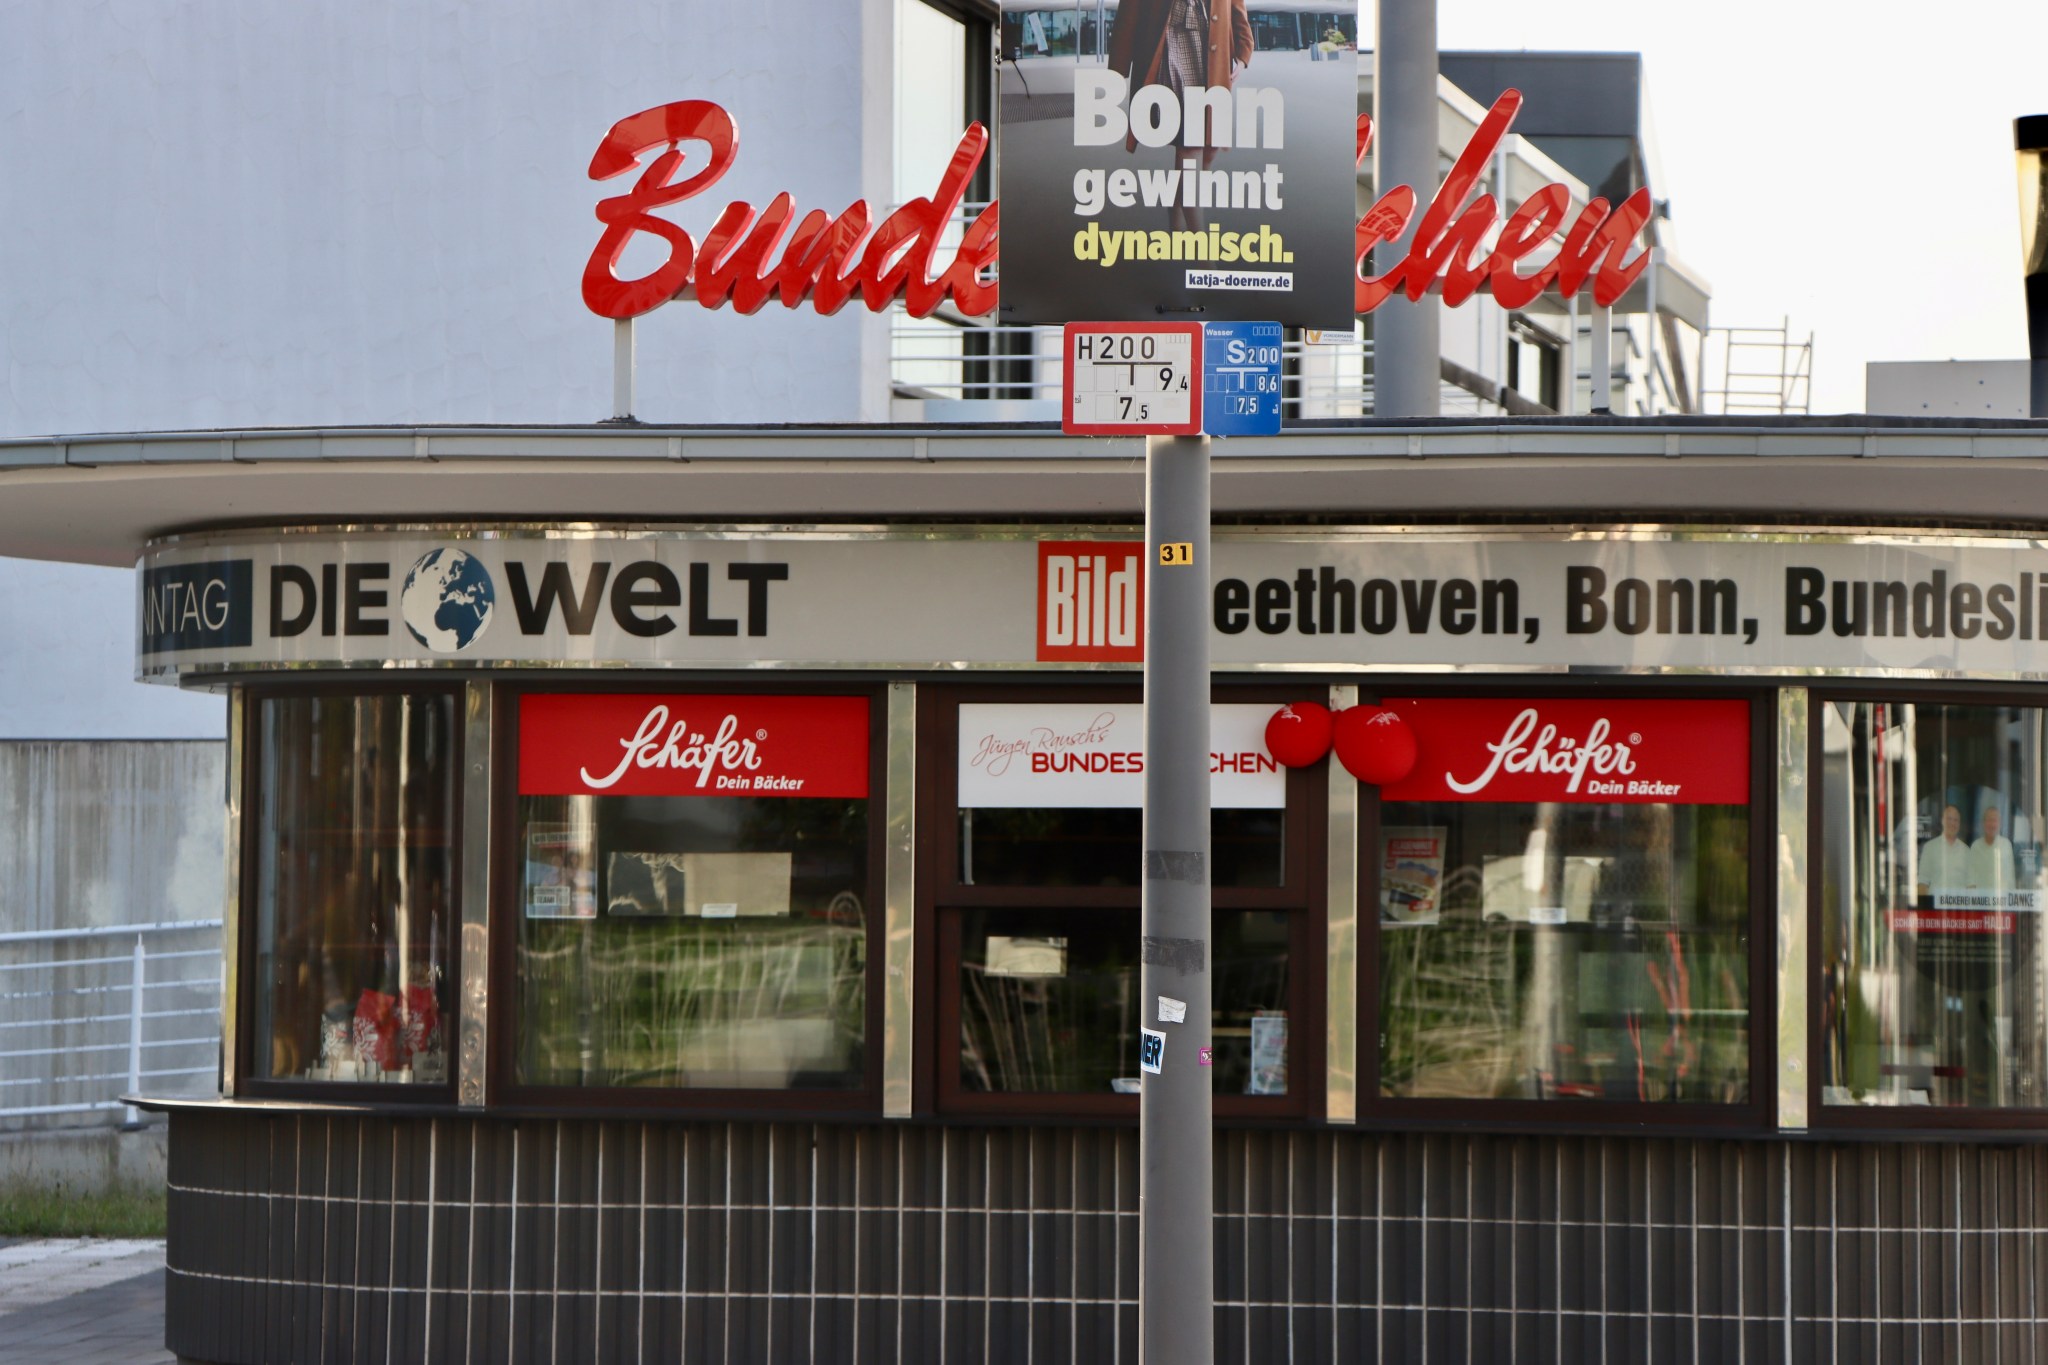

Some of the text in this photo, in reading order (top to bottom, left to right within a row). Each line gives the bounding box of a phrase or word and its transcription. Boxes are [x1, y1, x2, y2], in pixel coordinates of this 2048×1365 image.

[1074, 68, 1284, 149] Bonn
[1073, 159, 1283, 216] gewinnt
[1074, 222, 1294, 267] dynamisch.
[1188, 273, 1290, 289] katja-doerner.de
[270, 562, 390, 638] DIE
[1046, 555, 1138, 647] Bild
[1213, 566, 1540, 644] eethoven,
[1566, 565, 1759, 644] Bonn,
[970, 733, 1034, 776] Jürgen
[716, 775, 804, 790] Dein Bäcker
[1587, 780, 1681, 796] Dein Bäcker
[2008, 893, 2034, 907] DANKE
